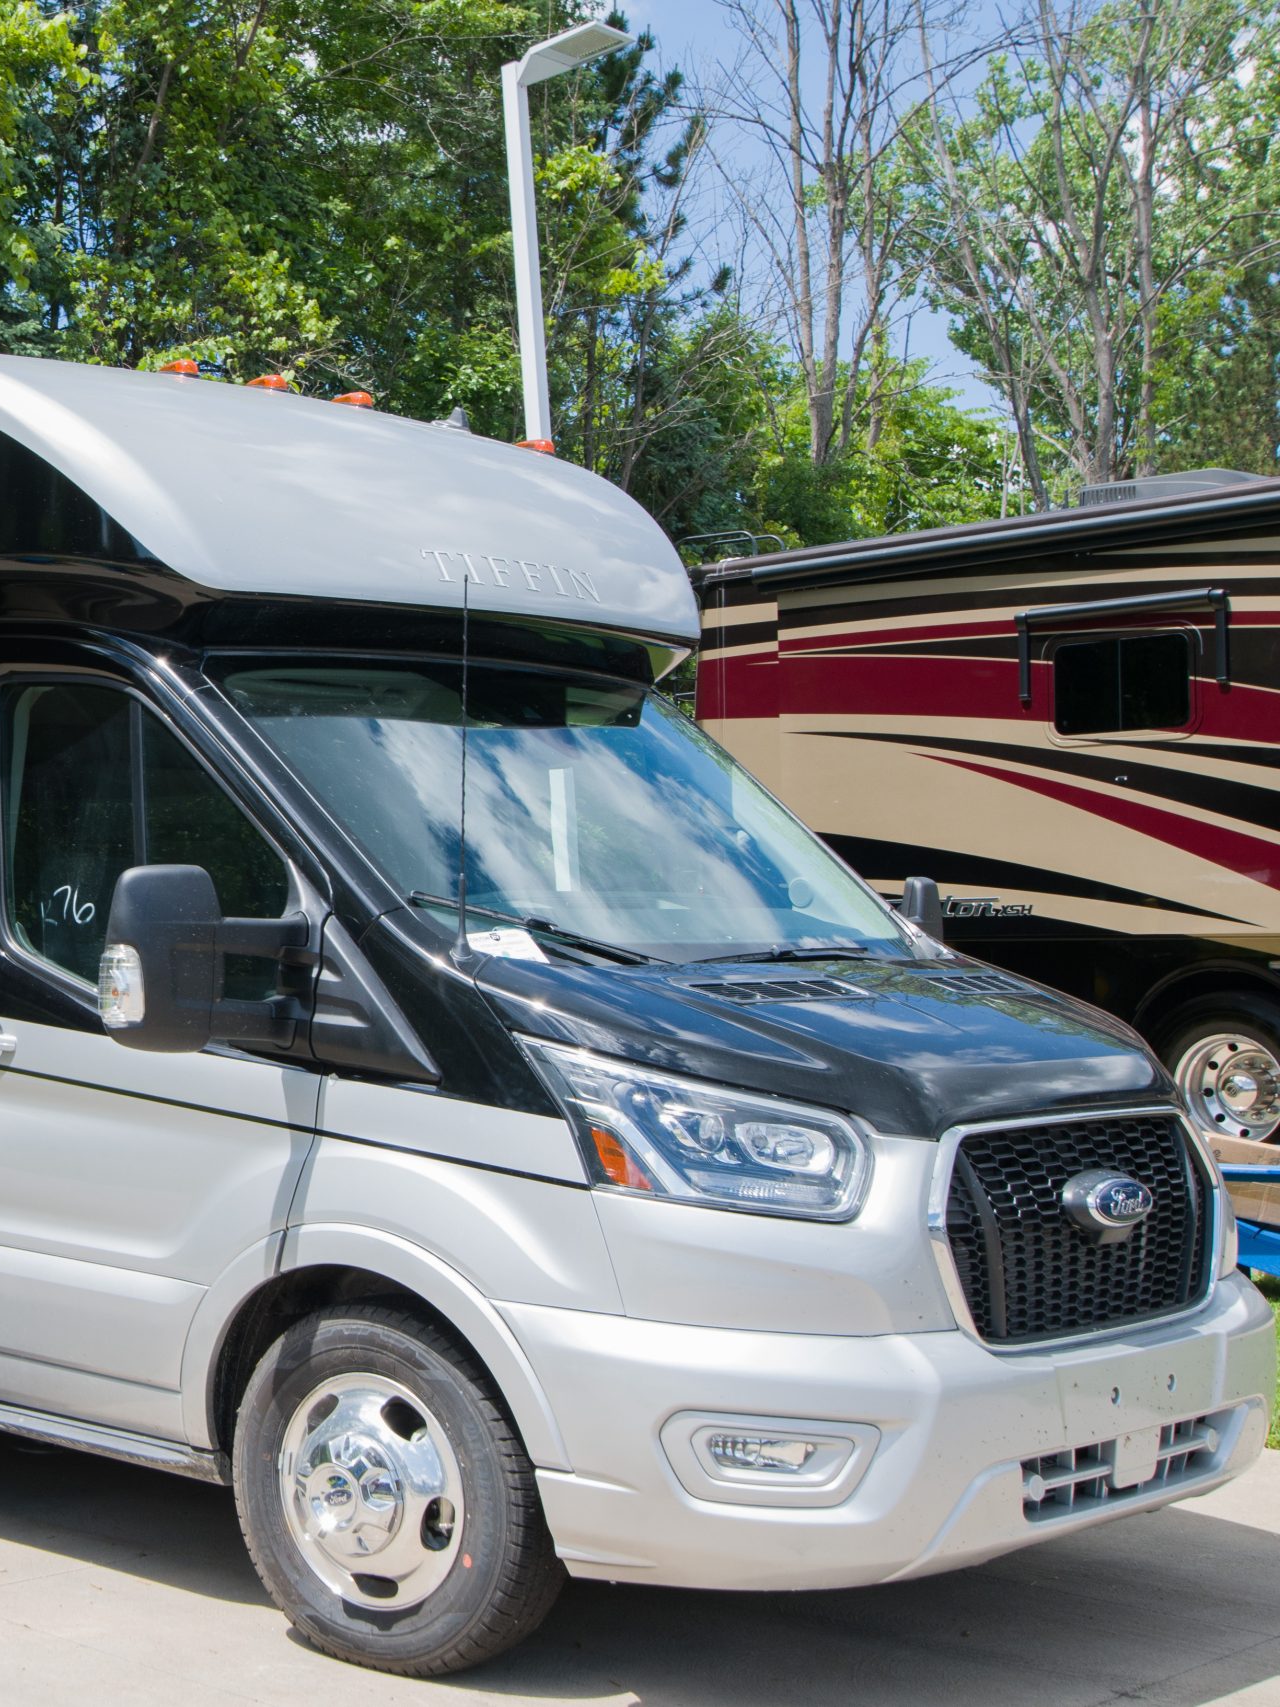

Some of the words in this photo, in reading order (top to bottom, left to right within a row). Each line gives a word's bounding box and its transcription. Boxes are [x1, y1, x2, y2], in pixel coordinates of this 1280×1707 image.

[420, 548, 601, 603] TIFFIN
[997, 904, 1034, 917] XSH
[1111, 1186, 1146, 1215] Ford
[329, 1491, 349, 1504] Ford
